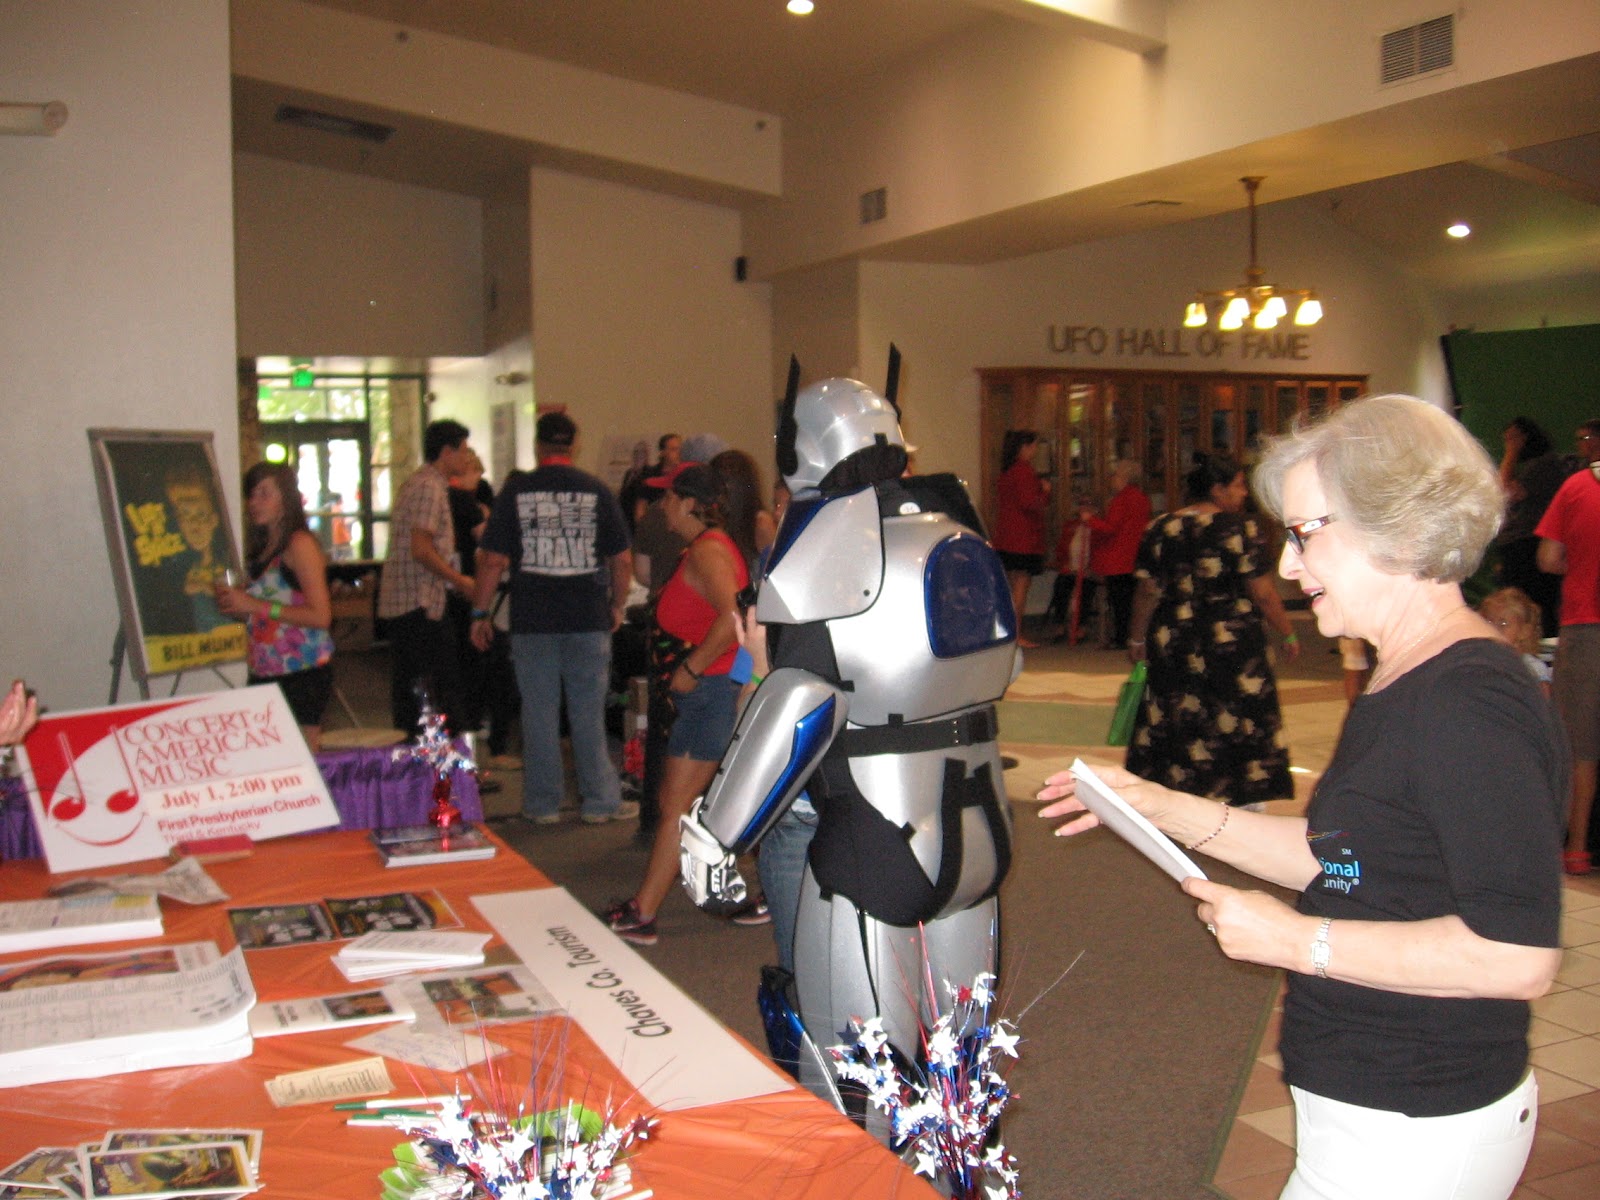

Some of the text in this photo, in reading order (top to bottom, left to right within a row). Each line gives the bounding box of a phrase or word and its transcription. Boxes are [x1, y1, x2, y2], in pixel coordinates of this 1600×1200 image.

[1048, 325, 1310, 361] UFO HALL OF FAME
[520, 536, 598, 568] BRAVE
[163, 642, 192, 663] BILL
[123, 699, 275, 745] CONCERT of
[136, 725, 283, 766] AMERICAN
[138, 755, 232, 787] MUSIC
[161, 773, 303, 810] July 1, 2:00 pm
[157, 794, 322, 833] First Presbyterian Church
[206, 820, 261, 839] Kentucky
[546, 926, 673, 1038] Chaves Co. Tourism
